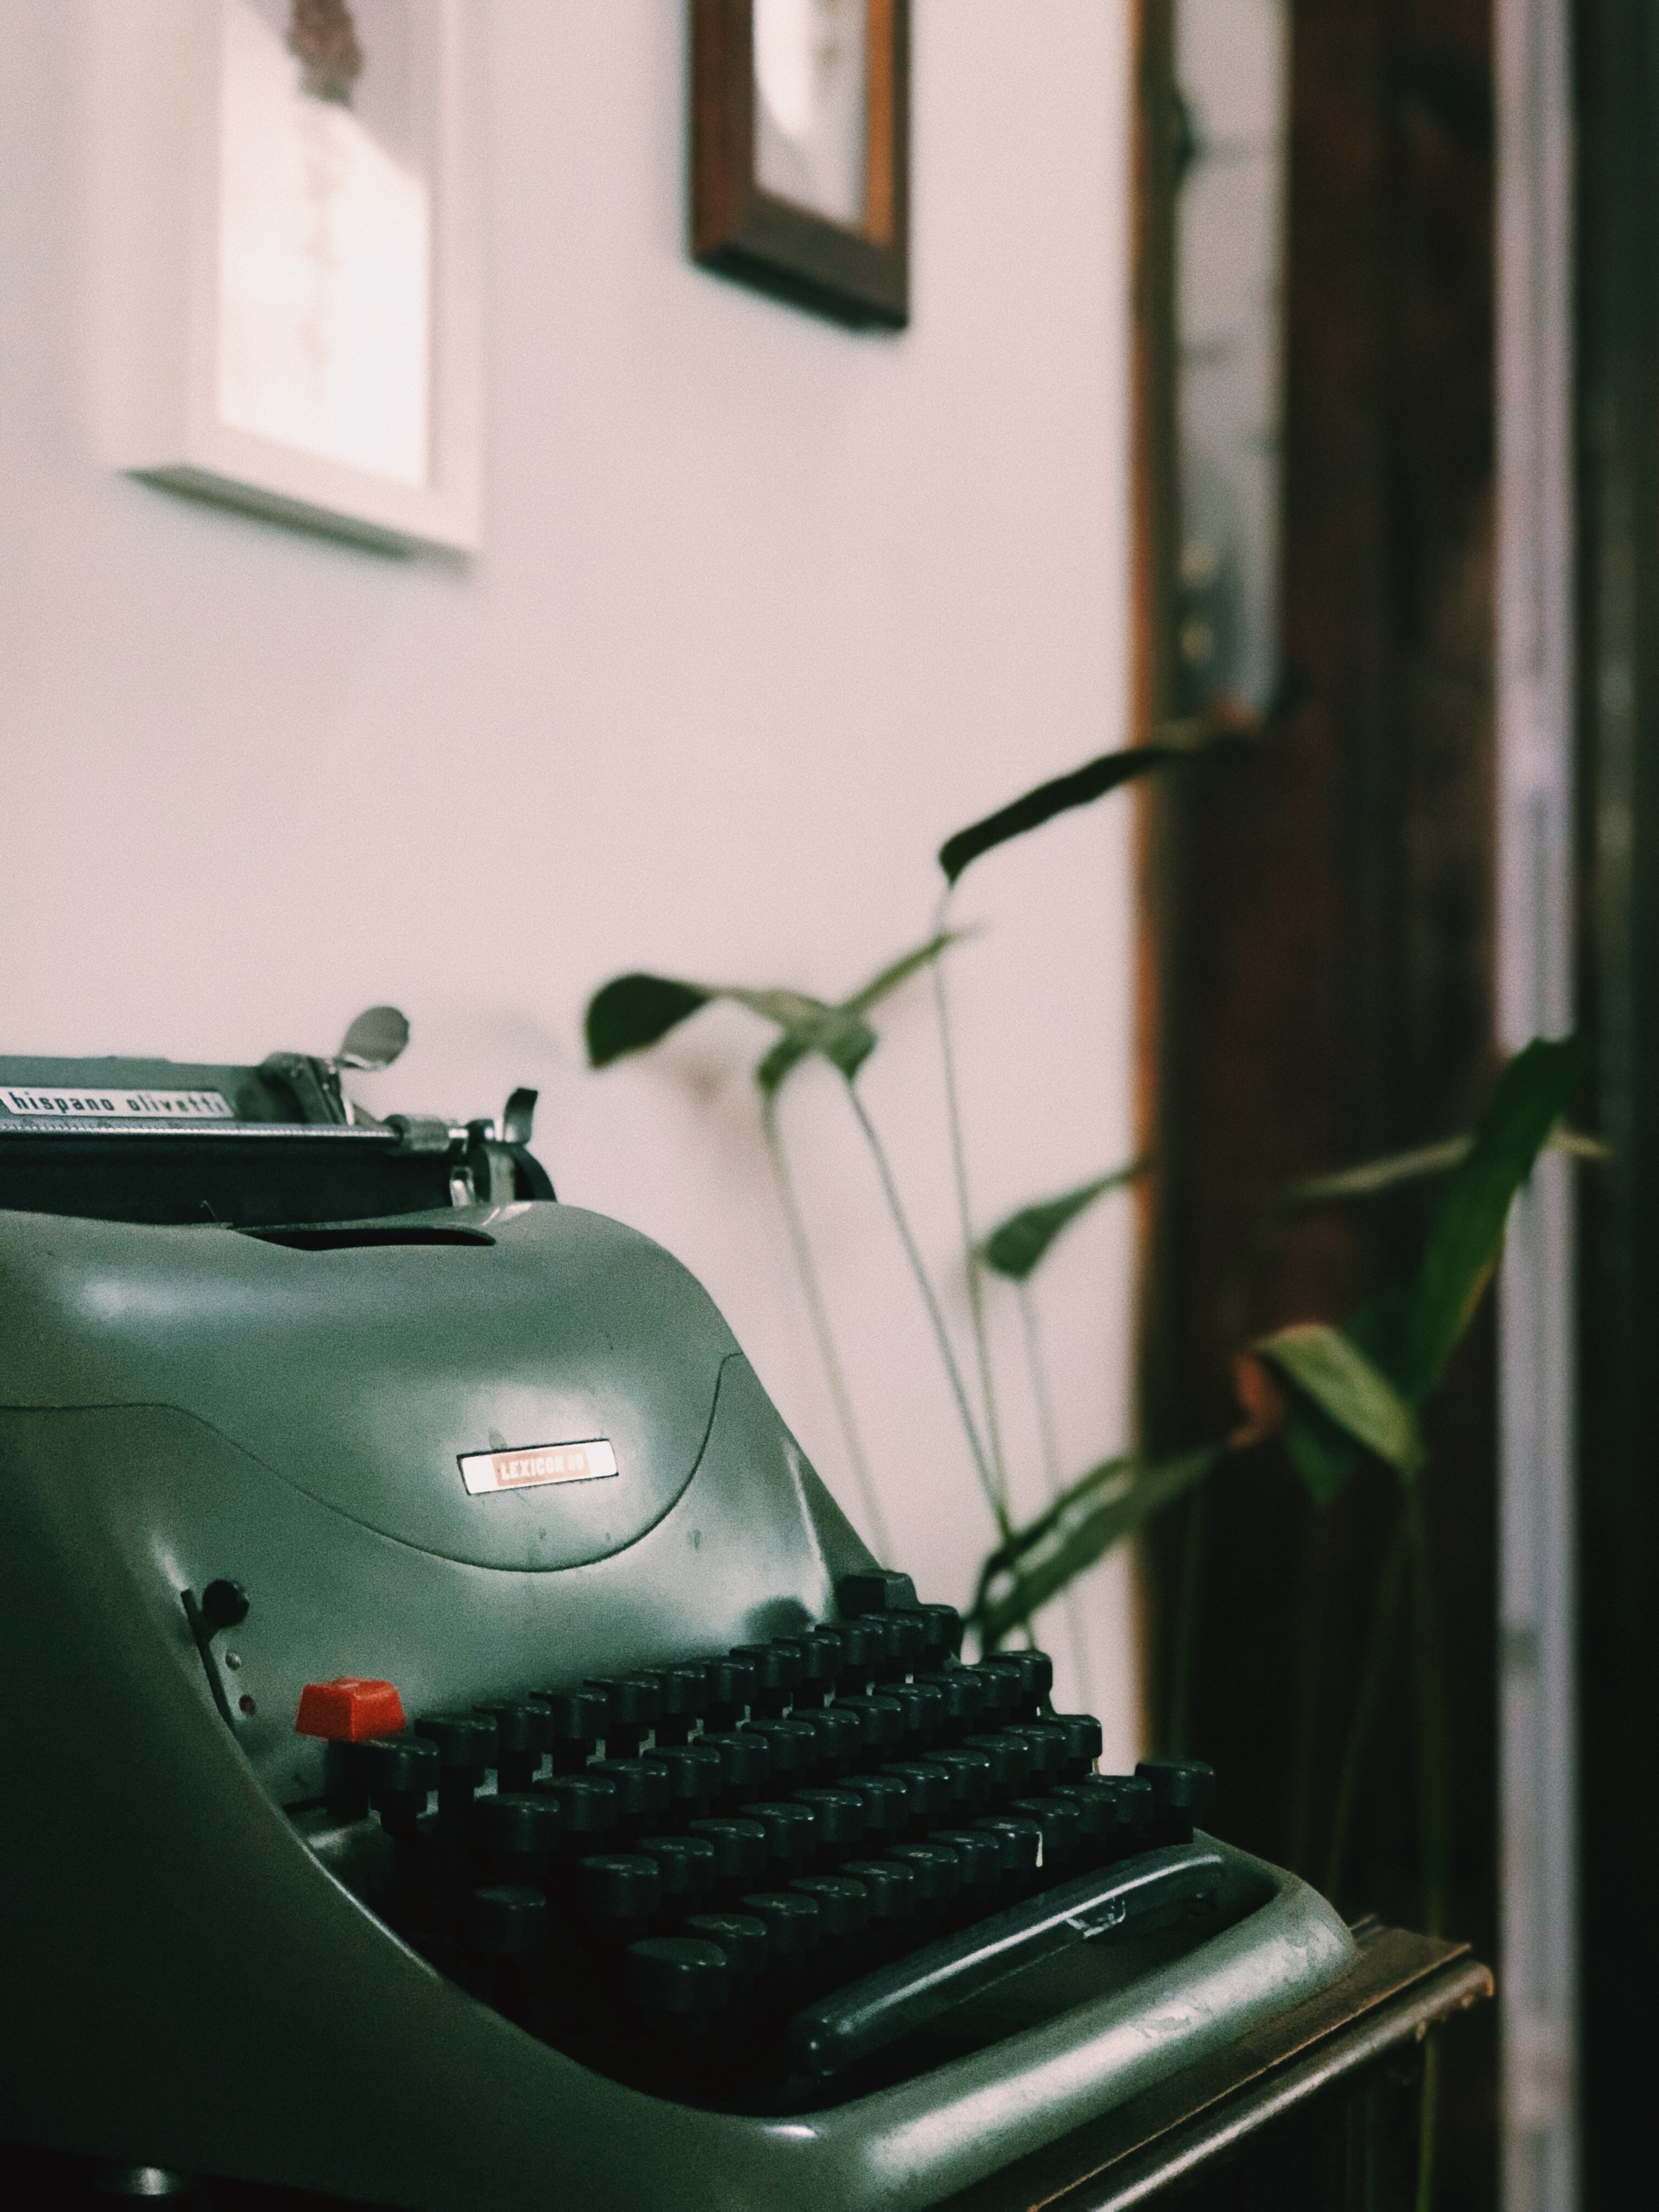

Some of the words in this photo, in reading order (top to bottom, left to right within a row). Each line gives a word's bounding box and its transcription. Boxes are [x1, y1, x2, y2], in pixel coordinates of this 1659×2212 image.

[8, 1091, 115, 1114] hispano
[126, 1093, 225, 1113] olivetti
[500, 1455, 564, 1480] LEXICON
